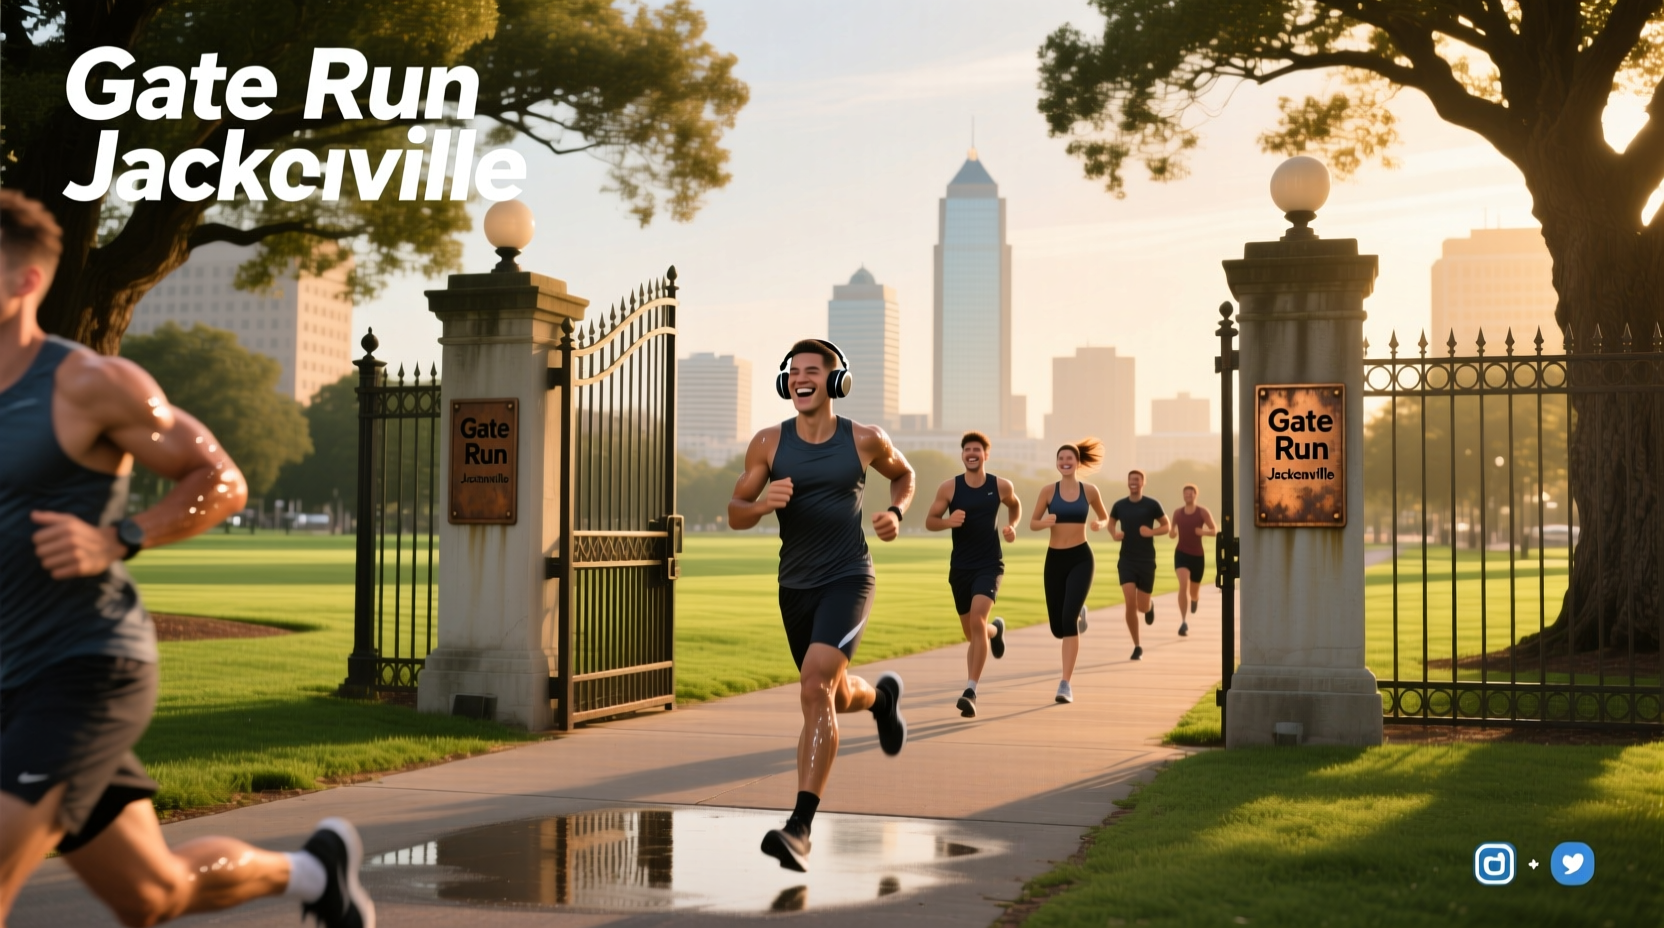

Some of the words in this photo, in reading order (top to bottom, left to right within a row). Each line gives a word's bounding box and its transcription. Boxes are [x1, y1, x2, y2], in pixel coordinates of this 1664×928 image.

[460, 417, 510, 439] Gate
[1268, 408, 1333, 432] Gate
[464, 442, 508, 465] Run
[1275, 436, 1329, 460] Run
